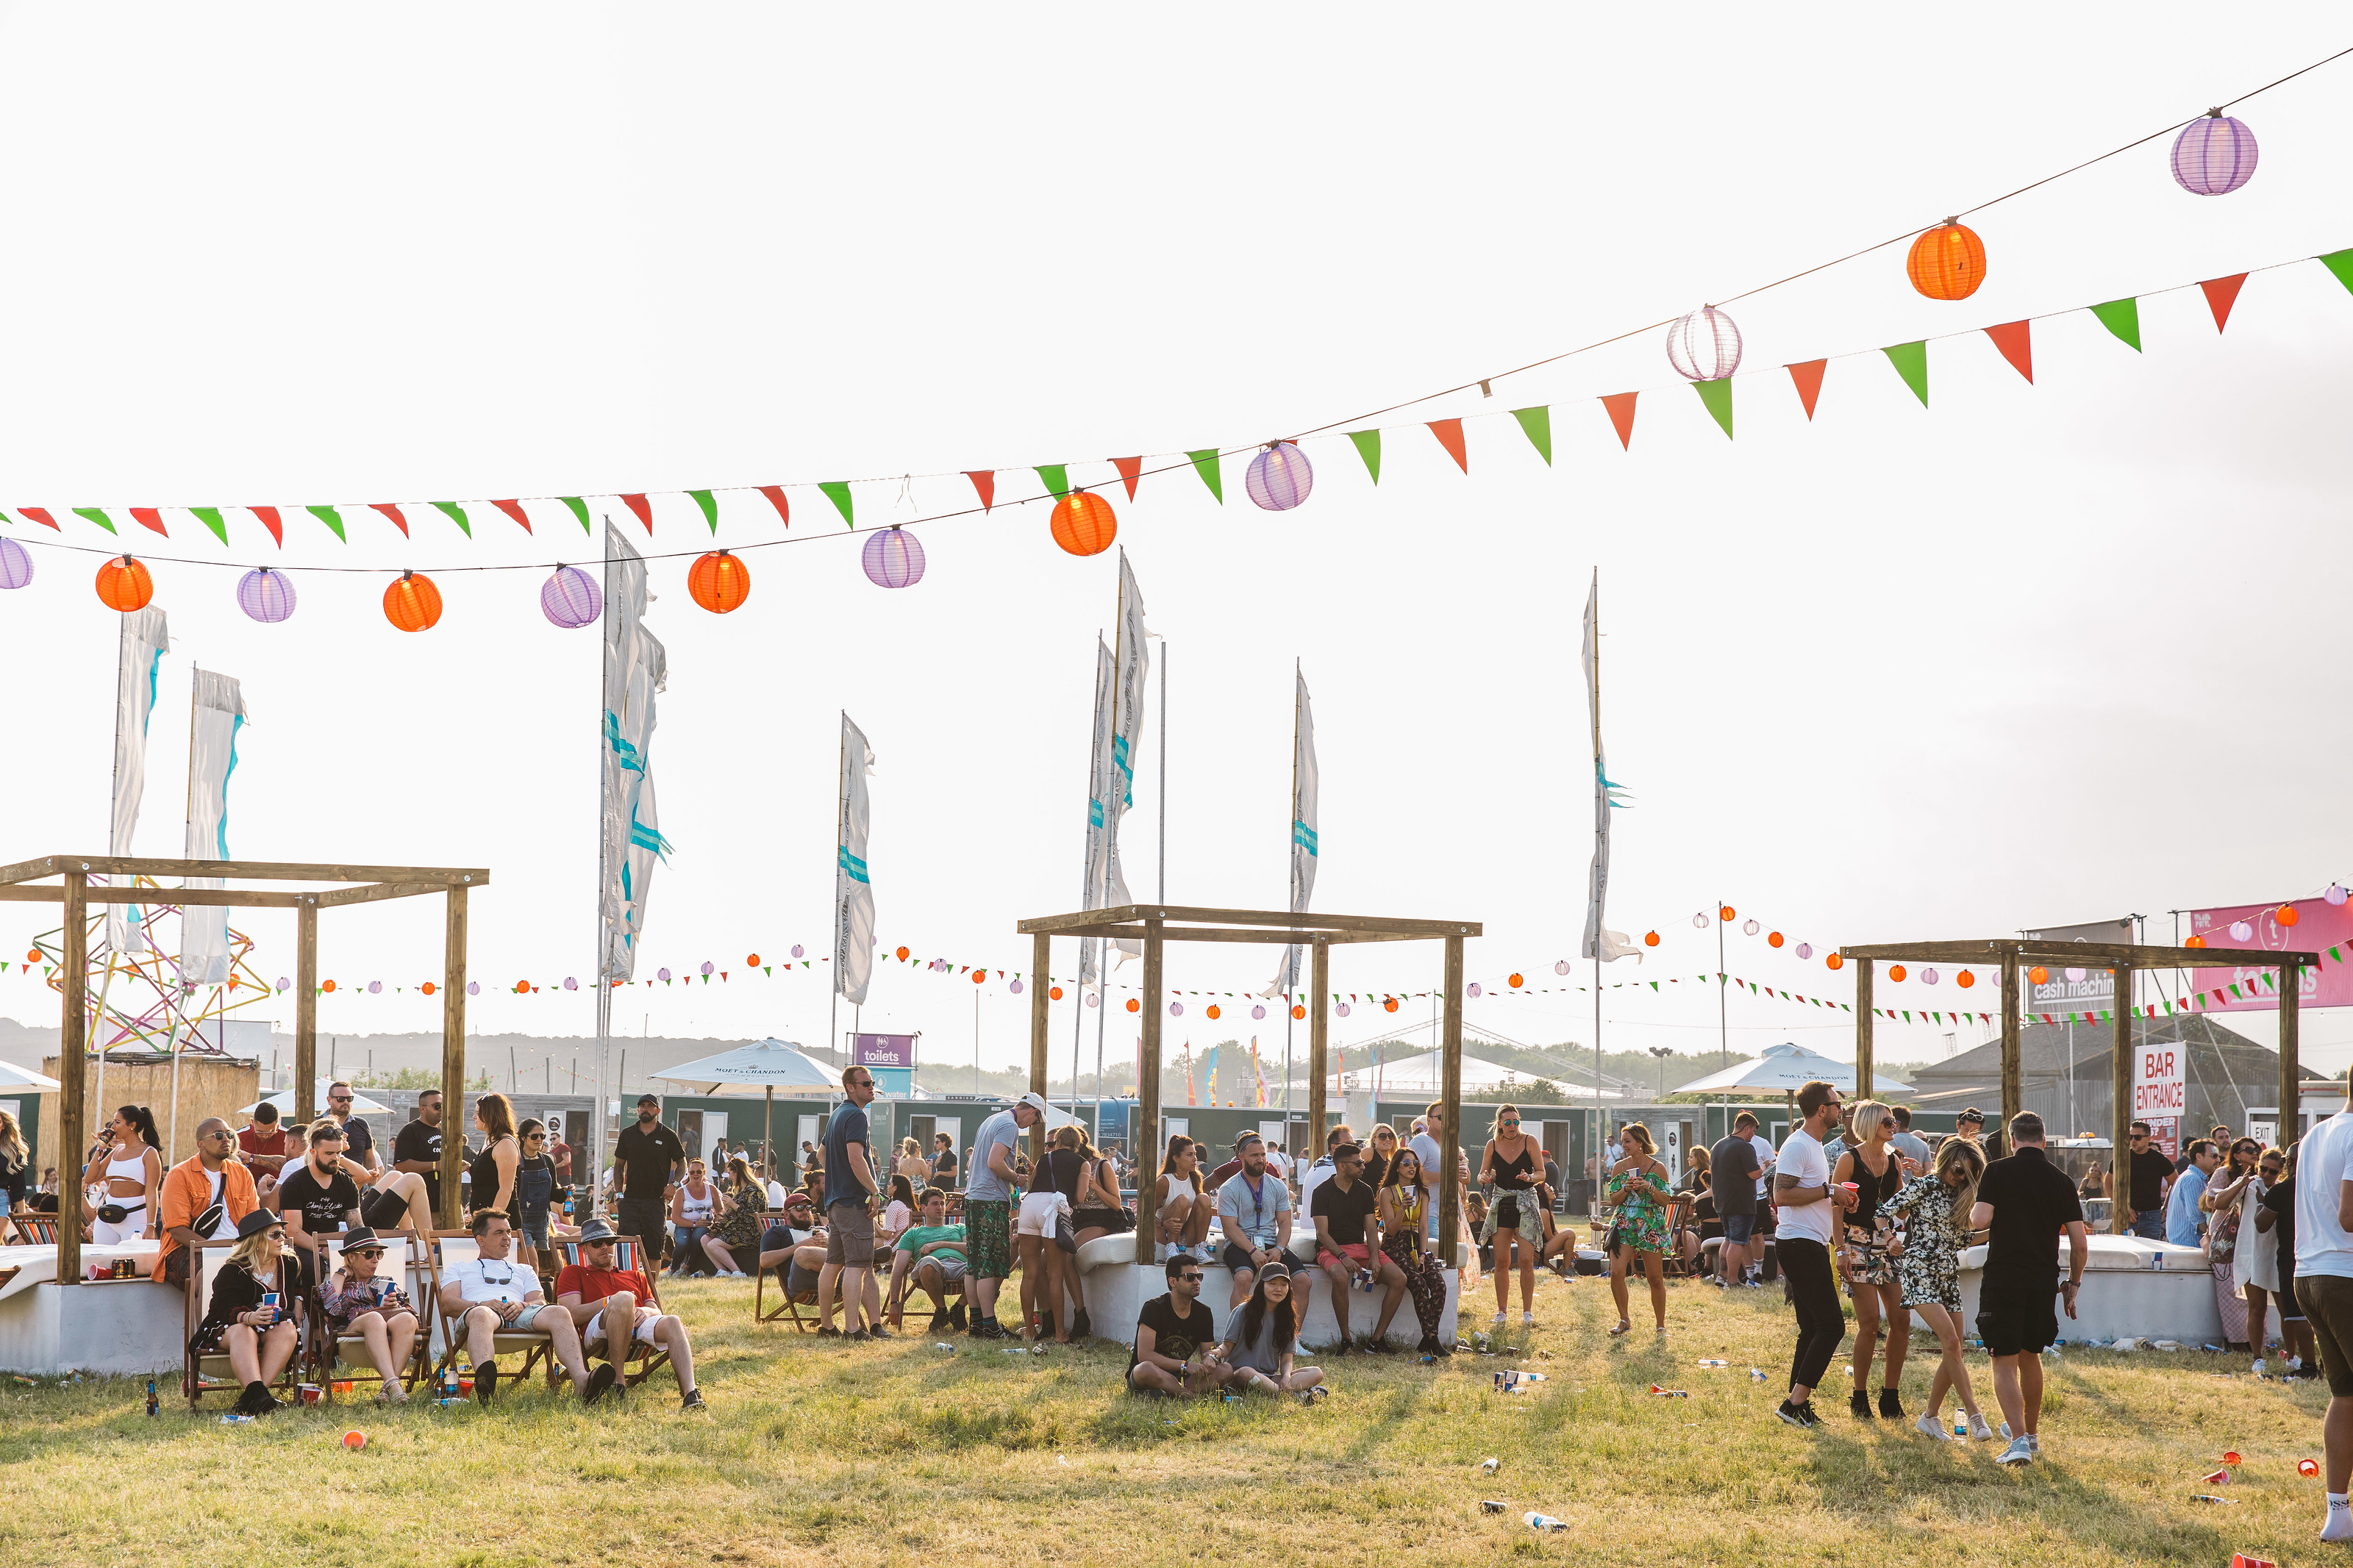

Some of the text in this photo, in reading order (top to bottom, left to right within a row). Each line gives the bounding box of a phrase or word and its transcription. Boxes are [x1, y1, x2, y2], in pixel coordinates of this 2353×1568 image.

[2034, 972, 2115, 1000] cash machin
[2232, 966, 2316, 997] toks
[864, 1049, 899, 1062] toilets
[2146, 1051, 2174, 1078] BAR
[885, 1091, 907, 1099] water
[2136, 1081, 2183, 1111] ENTRANCE
[2255, 1127, 2270, 1139] EXIT
